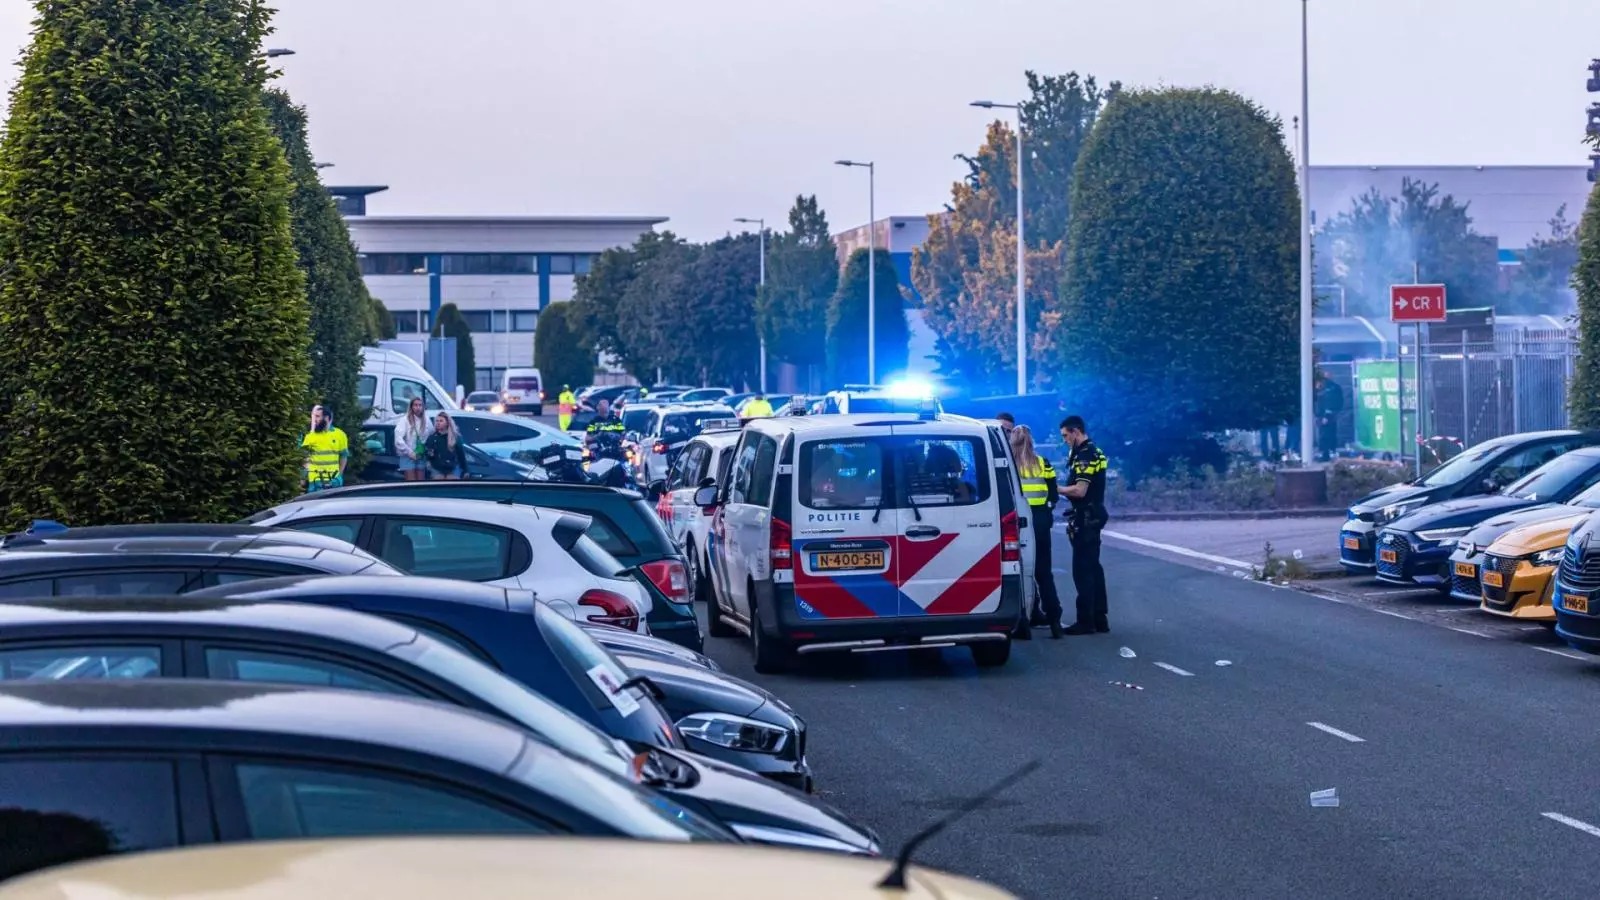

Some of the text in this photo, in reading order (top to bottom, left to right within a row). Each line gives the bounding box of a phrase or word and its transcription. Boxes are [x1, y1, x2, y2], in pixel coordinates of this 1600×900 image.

[1412, 296, 1441, 310] CR 1
[808, 513, 861, 522] POLITIE
[820, 553, 881, 566] N-400-SH
